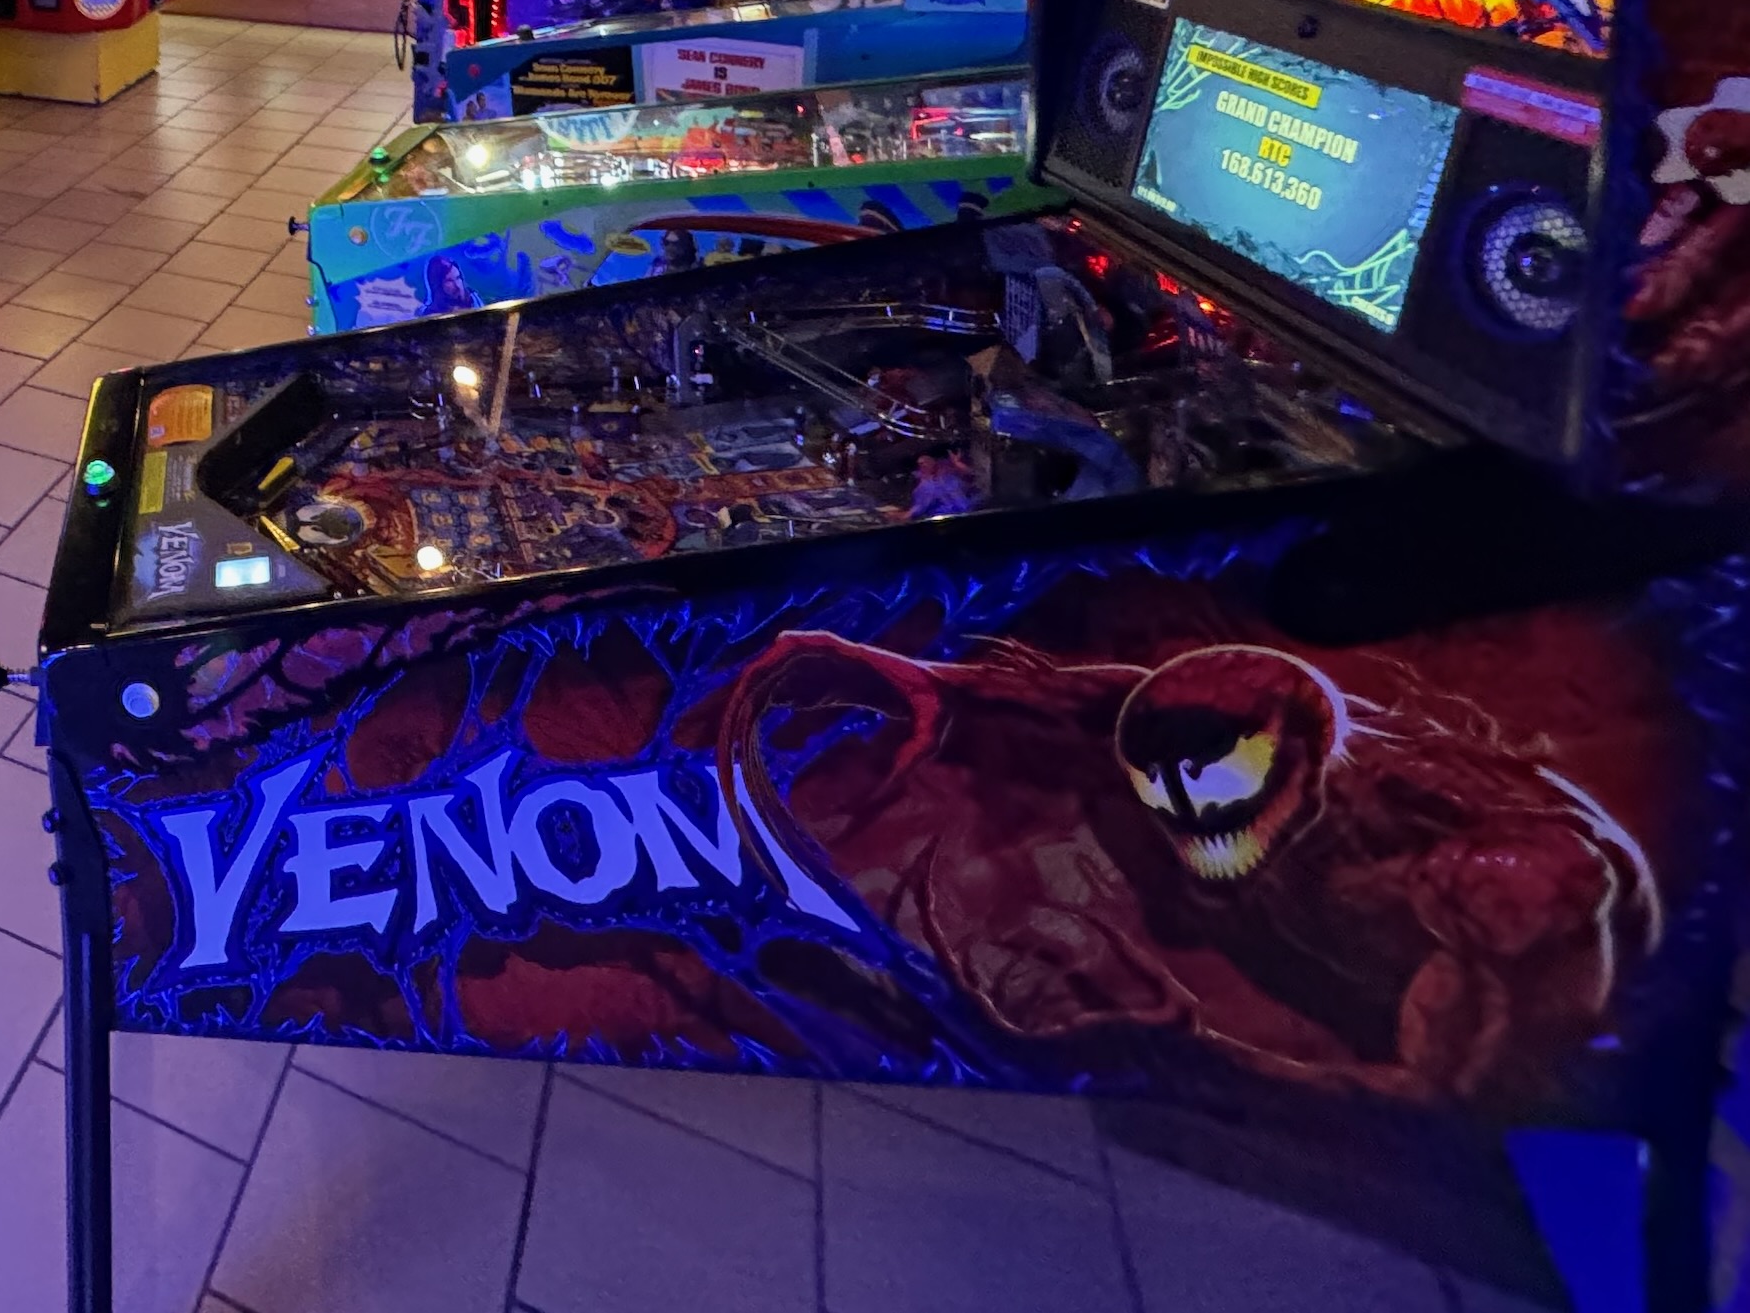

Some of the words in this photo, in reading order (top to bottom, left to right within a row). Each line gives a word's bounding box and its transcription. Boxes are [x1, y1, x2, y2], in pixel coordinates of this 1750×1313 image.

[714, 66, 728, 80] IS
[1196, 50, 1246, 79] IMPOSSIBLE
[1270, 76, 1310, 101] SCORES
[1215, 90, 1268, 128] GRAND
[1268, 110, 1360, 164] CHAMPION
[1221, 149, 1324, 211] 168,613,360
[148, 520, 202, 602] VENOM
[161, 739, 862, 971] VENOM
